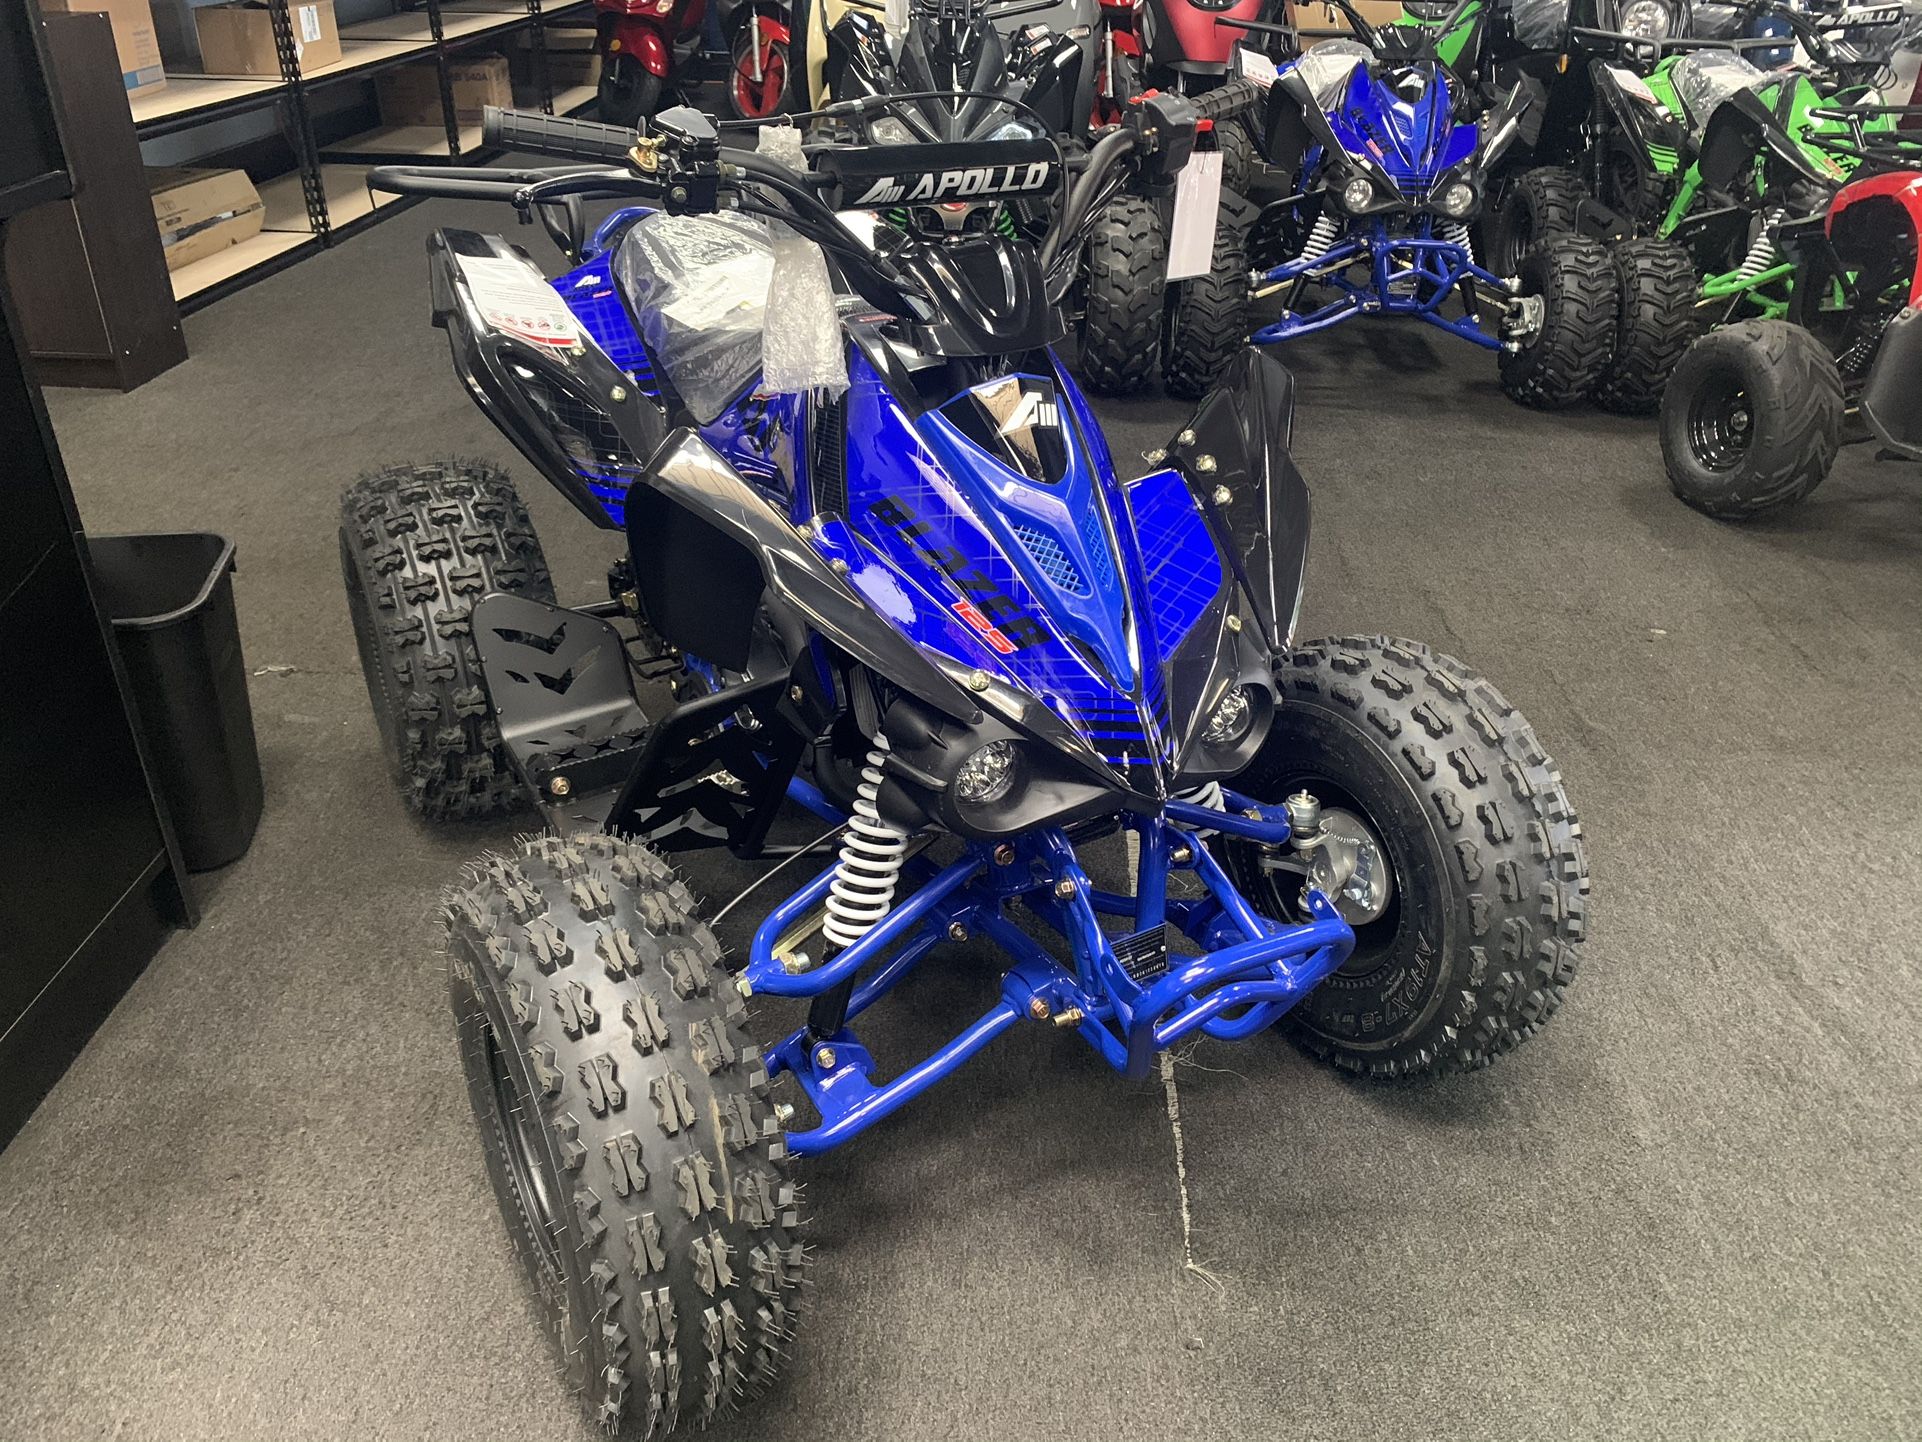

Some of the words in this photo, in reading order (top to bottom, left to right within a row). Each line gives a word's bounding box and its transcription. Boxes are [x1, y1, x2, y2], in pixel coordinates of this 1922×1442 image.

[1837, 10, 1899, 25] APOLLO
[906, 161, 1050, 201] APOLLO
[868, 495, 1051, 649] BLAZER
[951, 596, 1019, 654] 125
